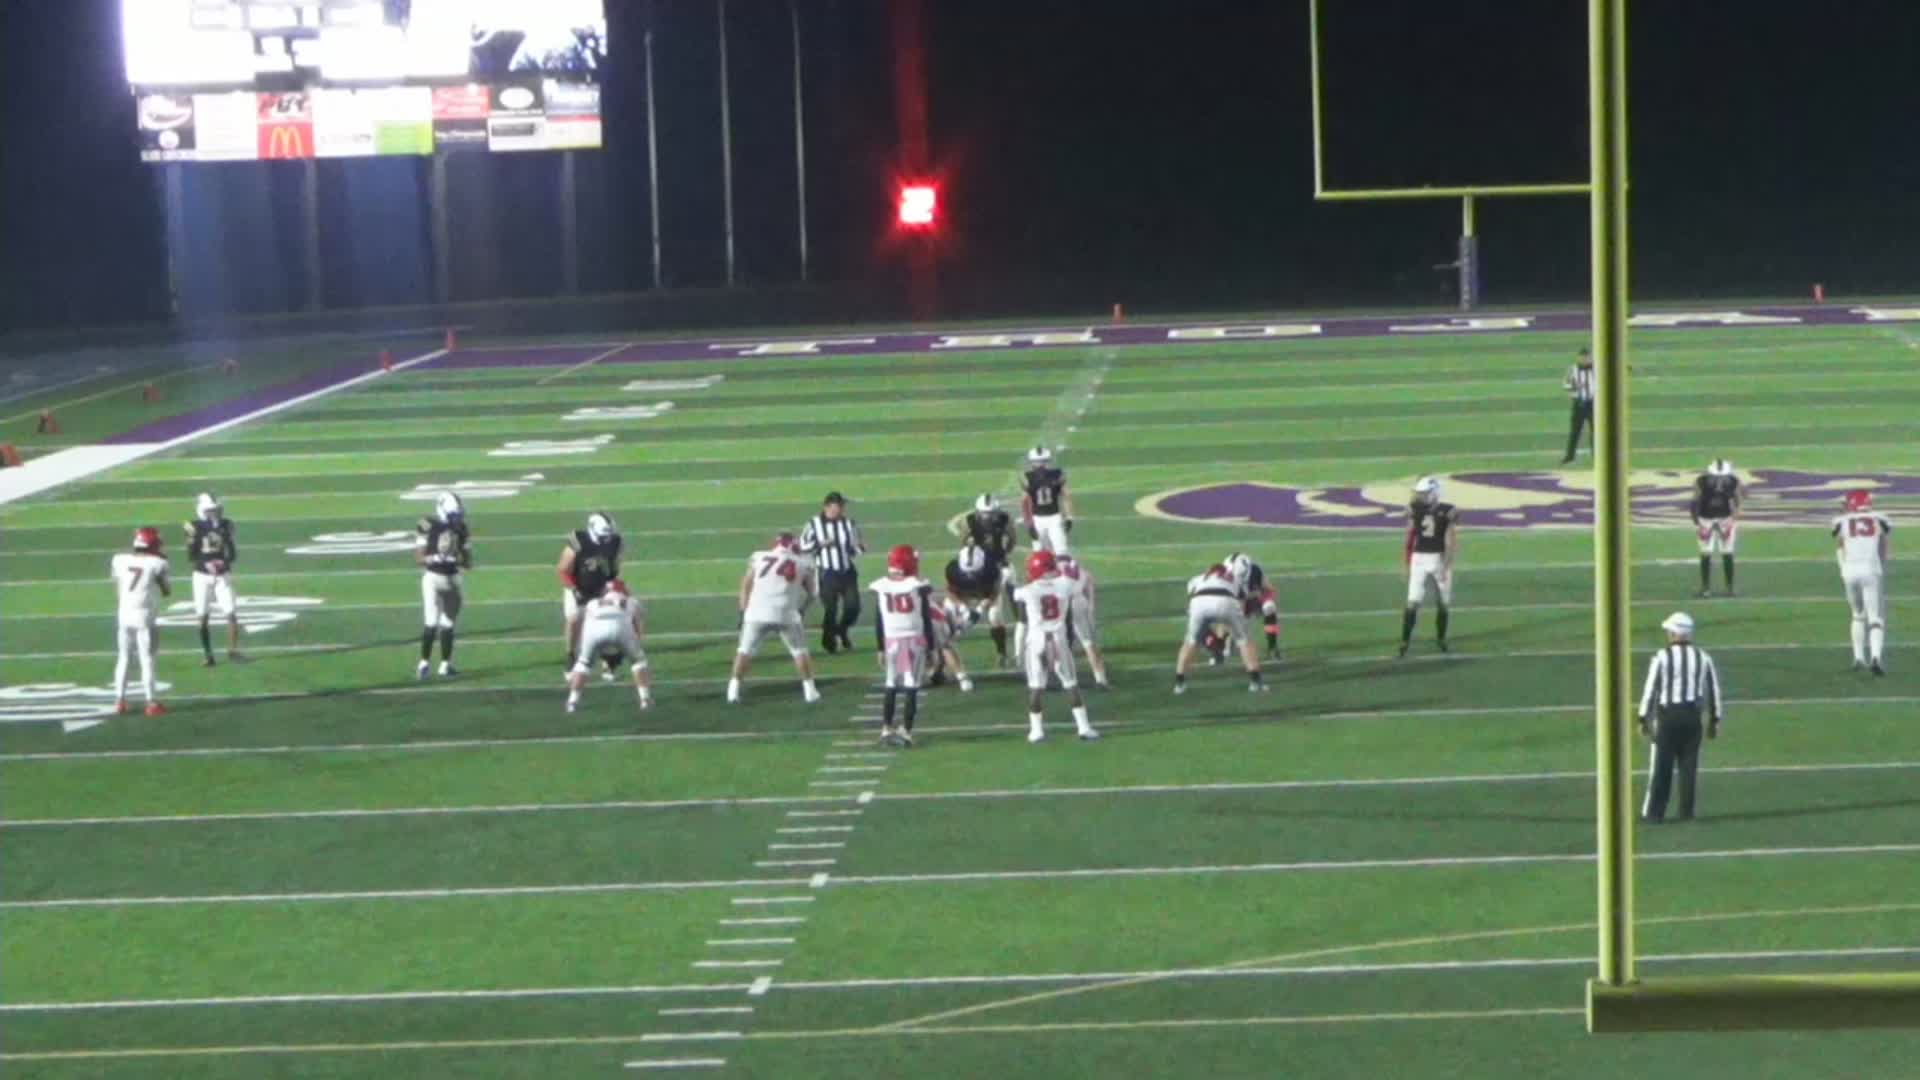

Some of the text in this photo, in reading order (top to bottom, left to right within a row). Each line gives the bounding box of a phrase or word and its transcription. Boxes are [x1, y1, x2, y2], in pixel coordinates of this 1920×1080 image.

[1848, 517, 1876, 538] 13
[128, 567, 144, 592] 7
[758, 556, 797, 582] 74
[885, 591, 916, 614] 10
[1040, 594, 1060, 621] 8
